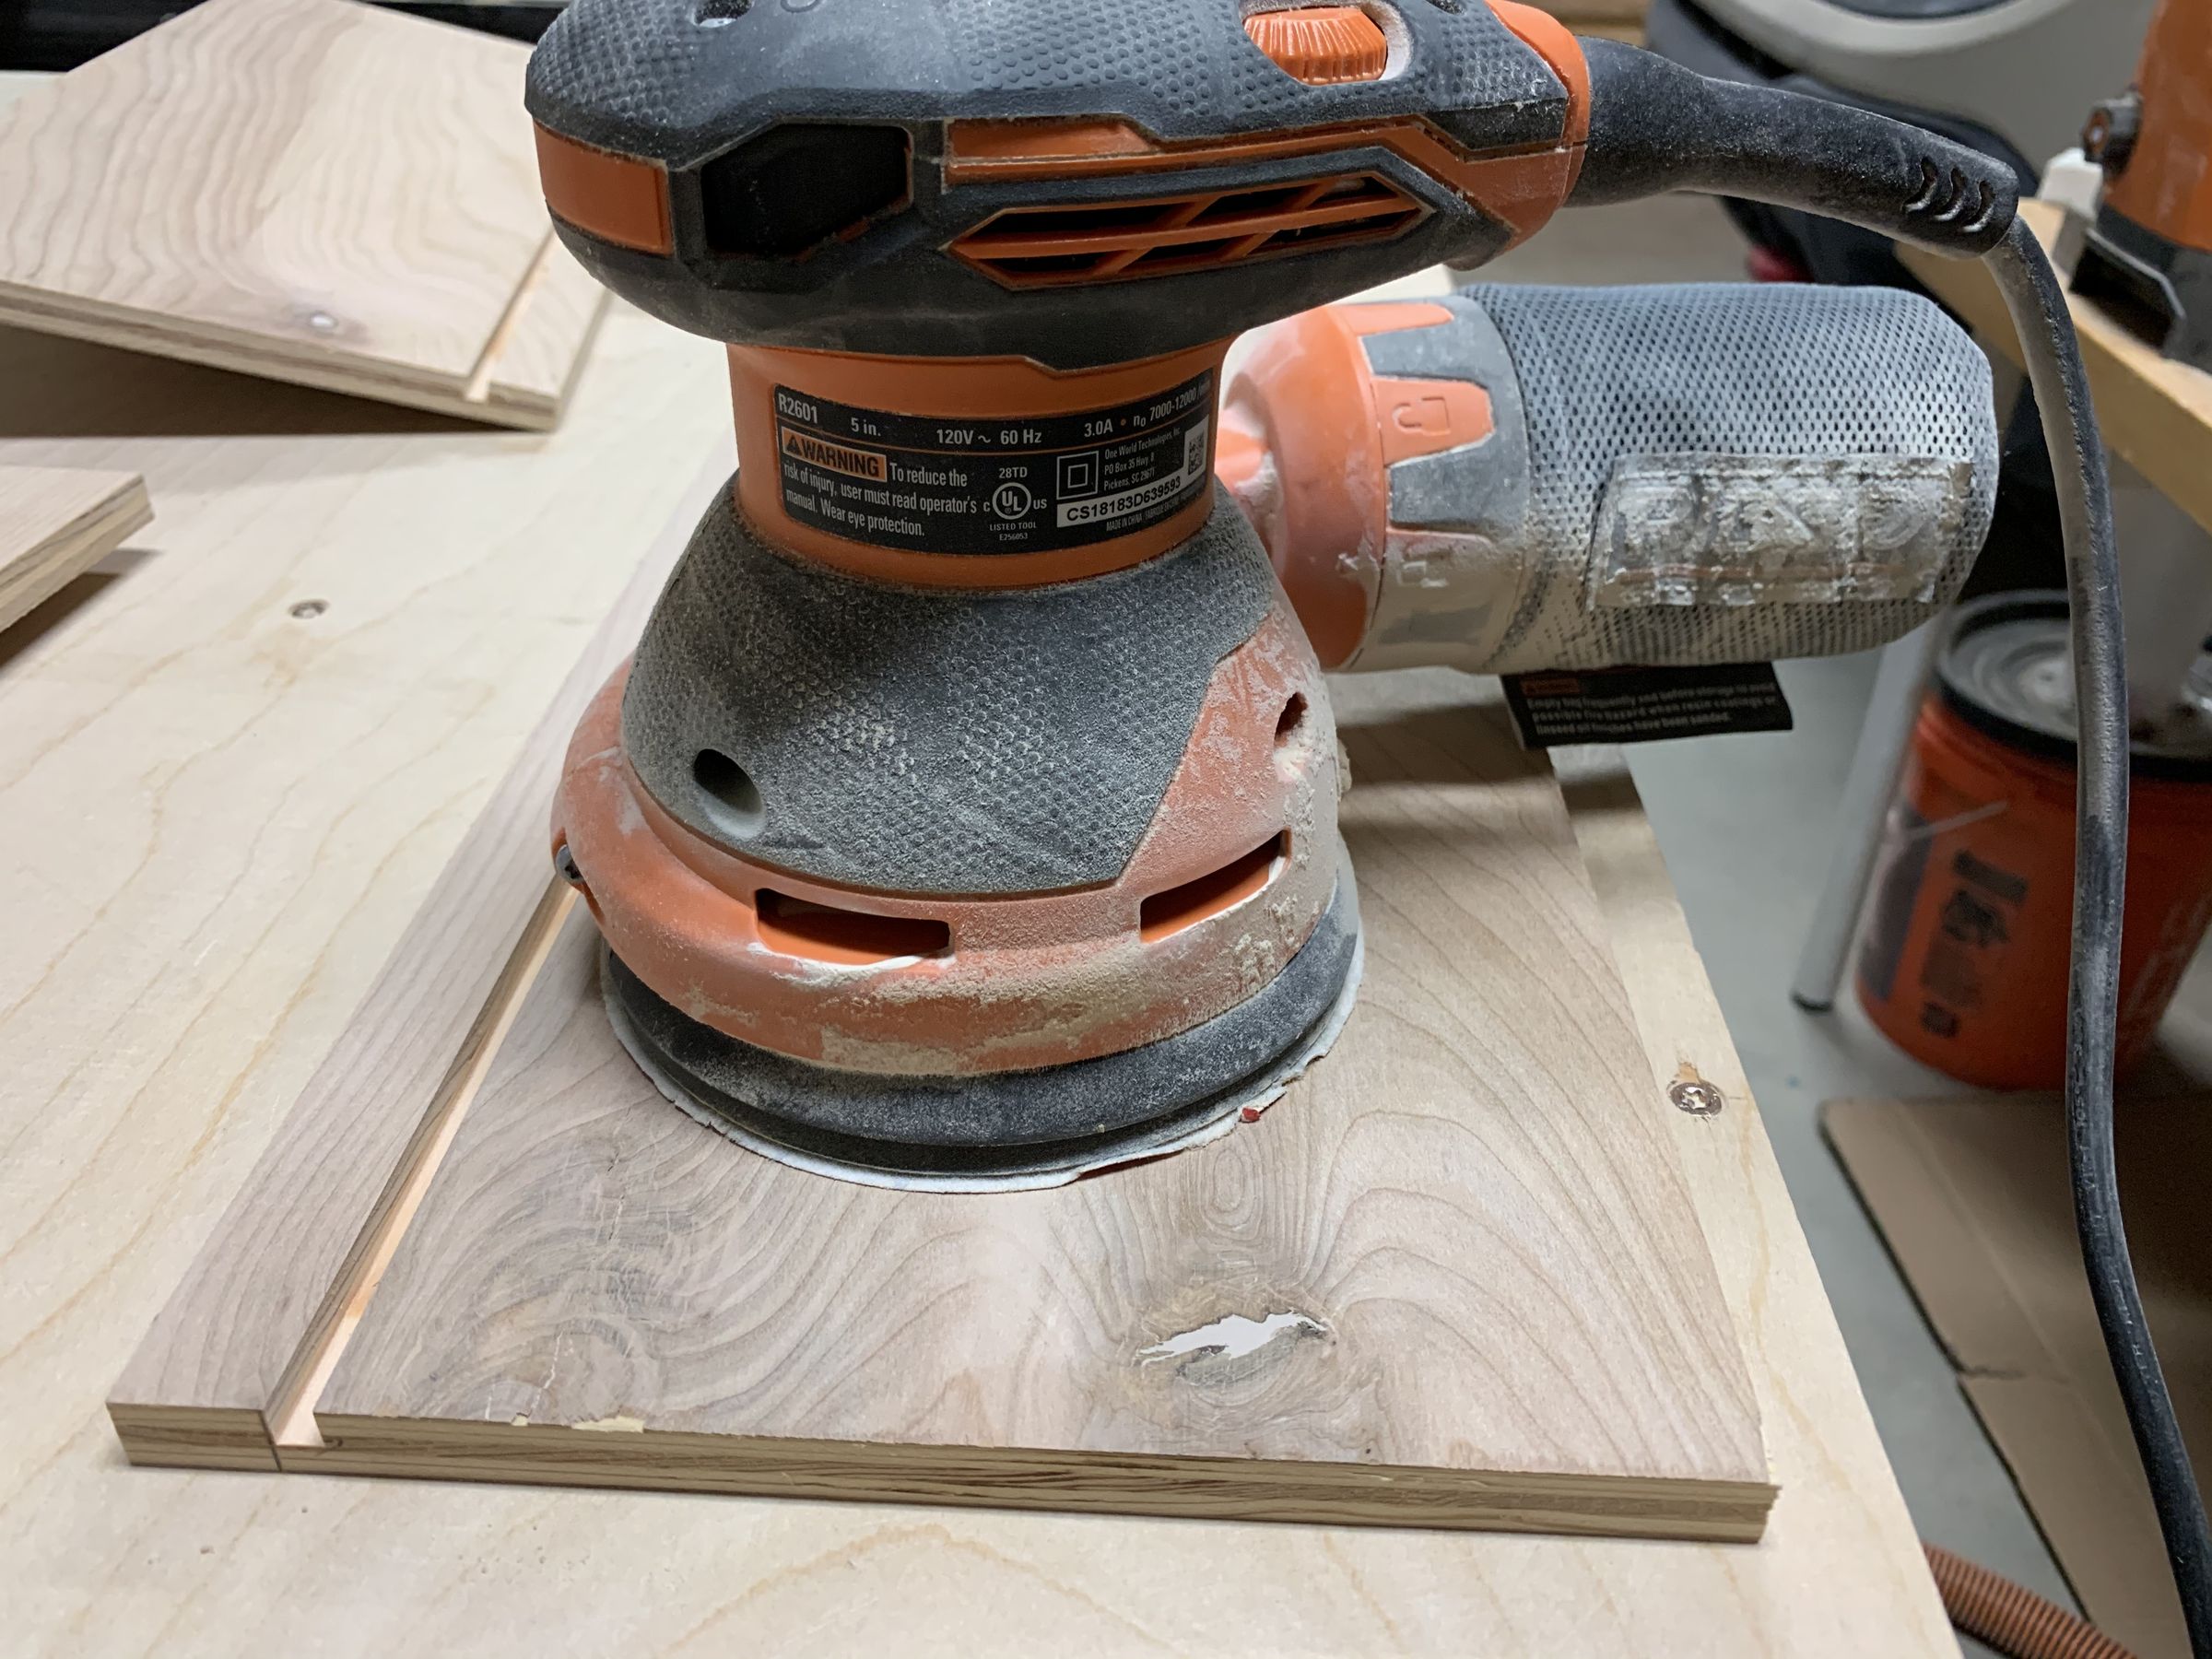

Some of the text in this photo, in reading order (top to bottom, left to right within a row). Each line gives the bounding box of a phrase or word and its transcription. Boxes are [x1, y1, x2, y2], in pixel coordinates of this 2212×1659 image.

[778, 393, 818, 424] R2601
[851, 418, 859, 431] 5
[863, 419, 881, 437] in.
[936, 429, 974, 444] 120V
[1000, 429, 1018, 444] 60
[1023, 429, 1041, 443] Hz
[1084, 418, 1113, 438] 3.0A
[1149, 387, 1197, 422] 7000-12000
[801, 438, 968, 488] WARNING To reduce the
[998, 466, 1029, 479] 28TD
[1105, 448, 1118, 460] One
[1118, 441, 1137, 457] World
[1114, 462, 1127, 474] Box
[783, 463, 977, 516] risk of injury, user must read operator's
[786, 488, 925, 536] manual. Wear eye protection.
[1066, 476, 1181, 522] CS18183D639593
[989, 521, 1037, 532] LISTED TOOL
